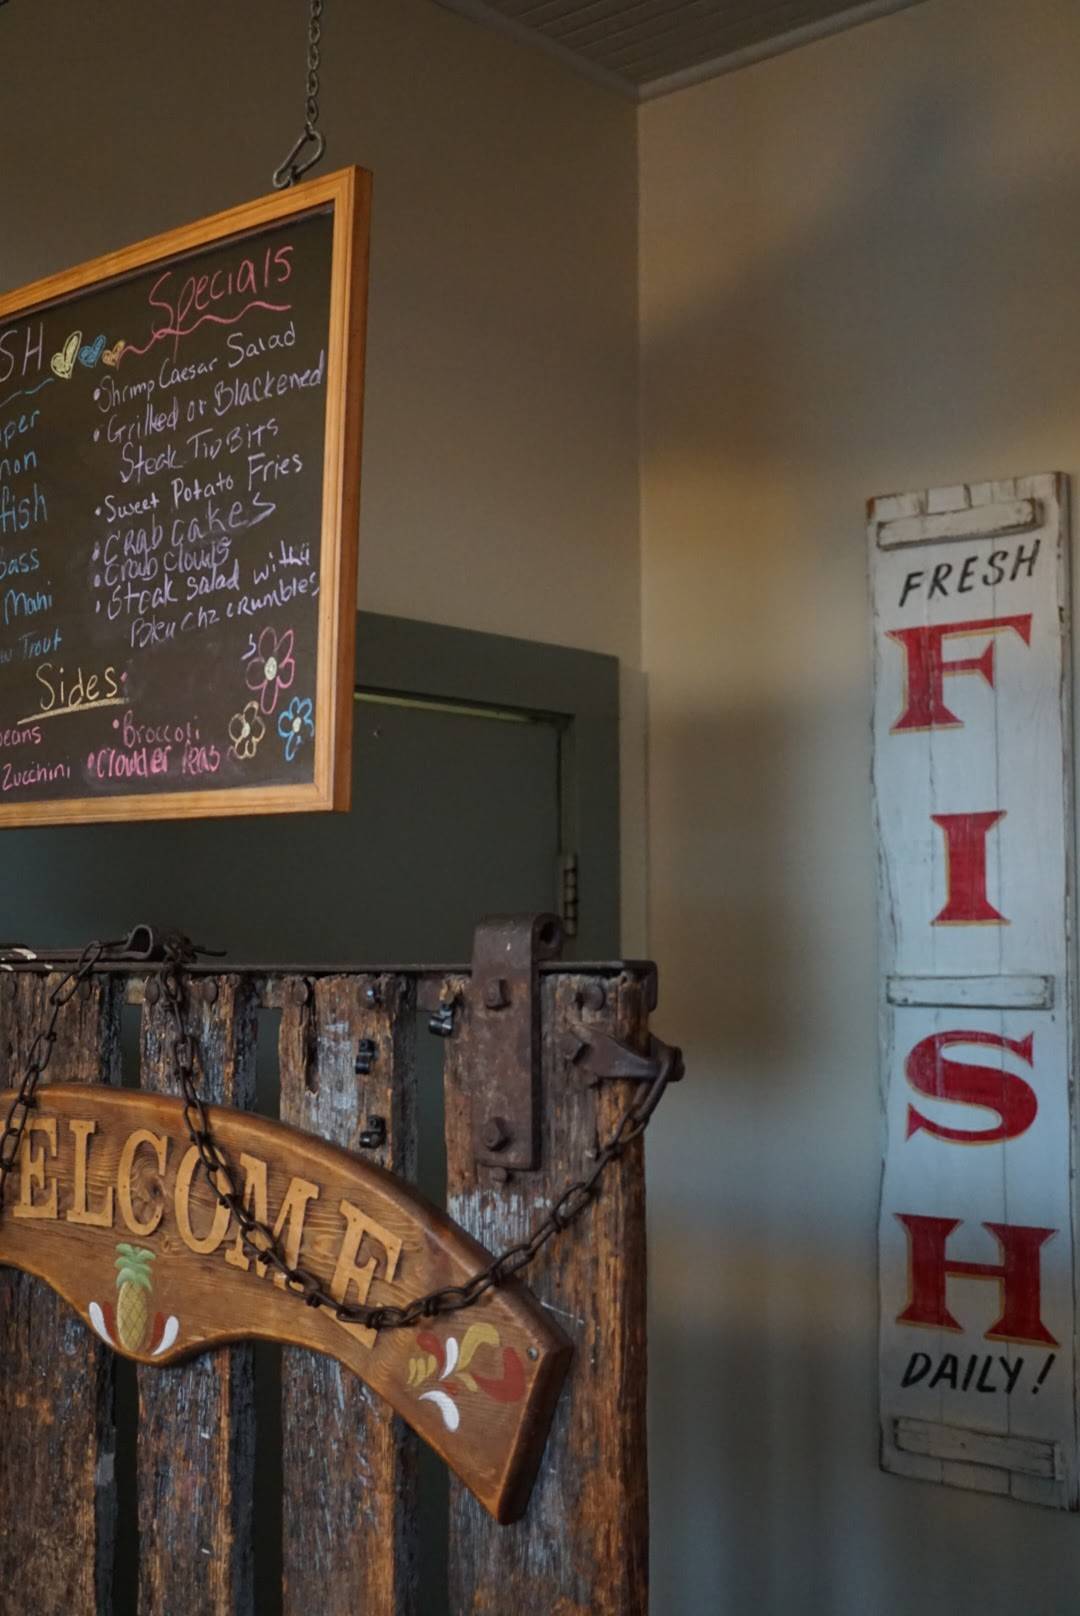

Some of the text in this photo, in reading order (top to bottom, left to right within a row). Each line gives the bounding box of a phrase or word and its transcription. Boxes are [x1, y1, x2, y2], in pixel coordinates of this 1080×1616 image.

[149, 246, 294, 363] Specials
[98, 321, 296, 413] Shrimp Caesar Salad
[107, 349, 325, 443] Grilled or Blackened
[0, 410, 40, 450] per
[120, 441, 184, 484] Steak
[104, 452, 303, 523] Sweet Potato Fries
[898, 537, 1041, 608] FRESH
[2, 755, 71, 791] Zucchini
[0, 1117, 402, 1350] ELCOME
